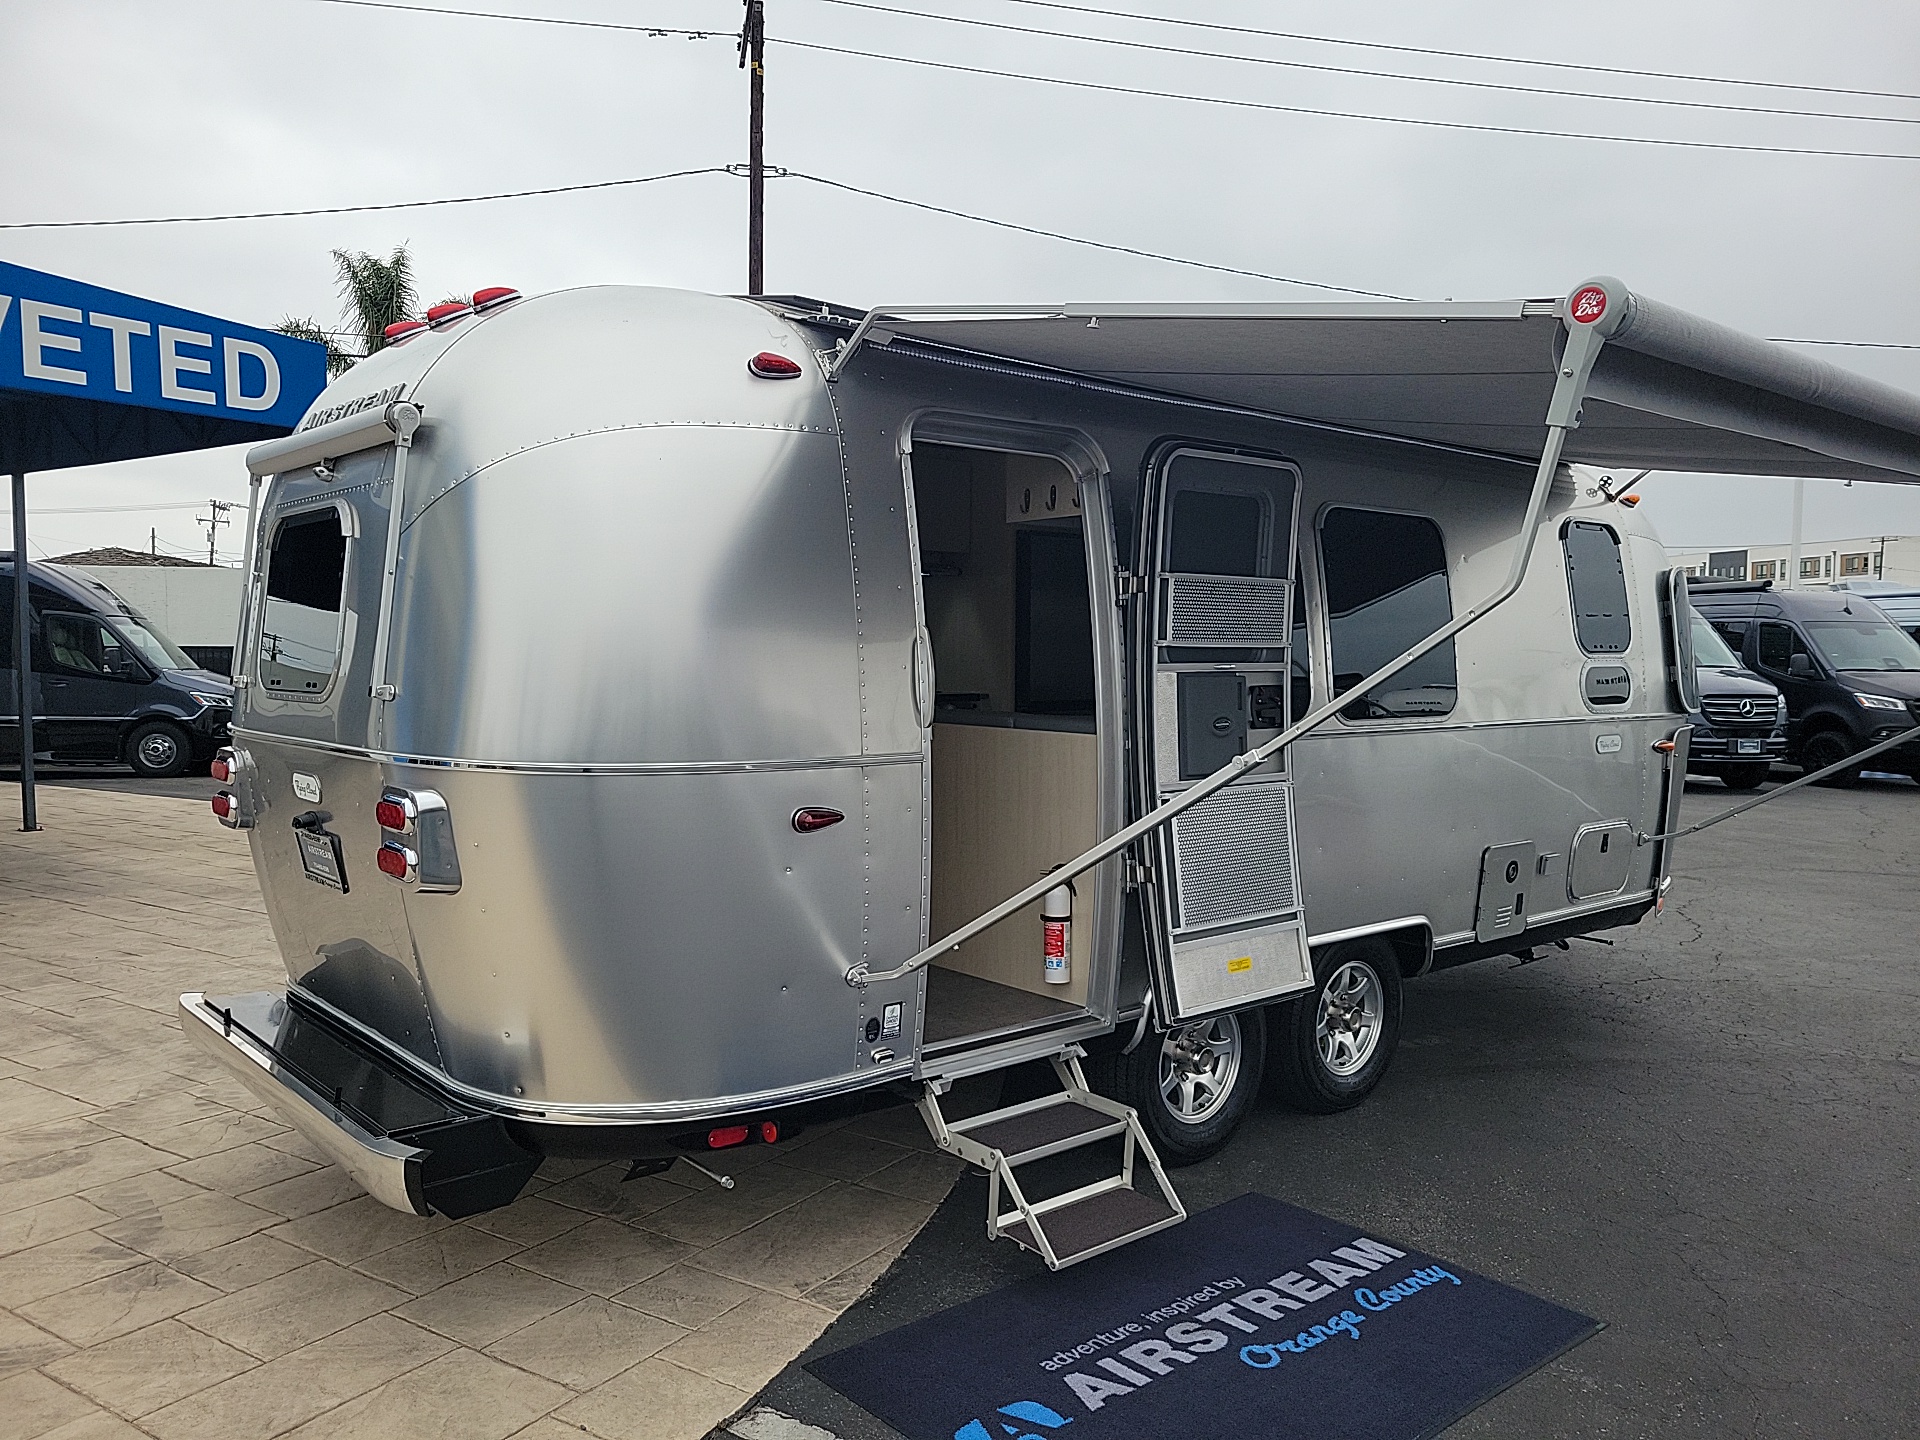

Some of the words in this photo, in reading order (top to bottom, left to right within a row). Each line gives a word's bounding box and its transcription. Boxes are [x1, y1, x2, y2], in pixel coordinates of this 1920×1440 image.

[1575, 304, 1602, 317] Dee
[1579, 291, 1604, 306] Zip
[0, 295, 281, 411] ETED
[1040, 1318, 1152, 1371] adventure,
[1143, 1284, 1217, 1326] inspired
[1216, 1275, 1245, 1300] by
[1063, 1236, 1408, 1412] AIRSTREAM
[1239, 1308, 1366, 1369] Orange
[1354, 1261, 1463, 1312] County
